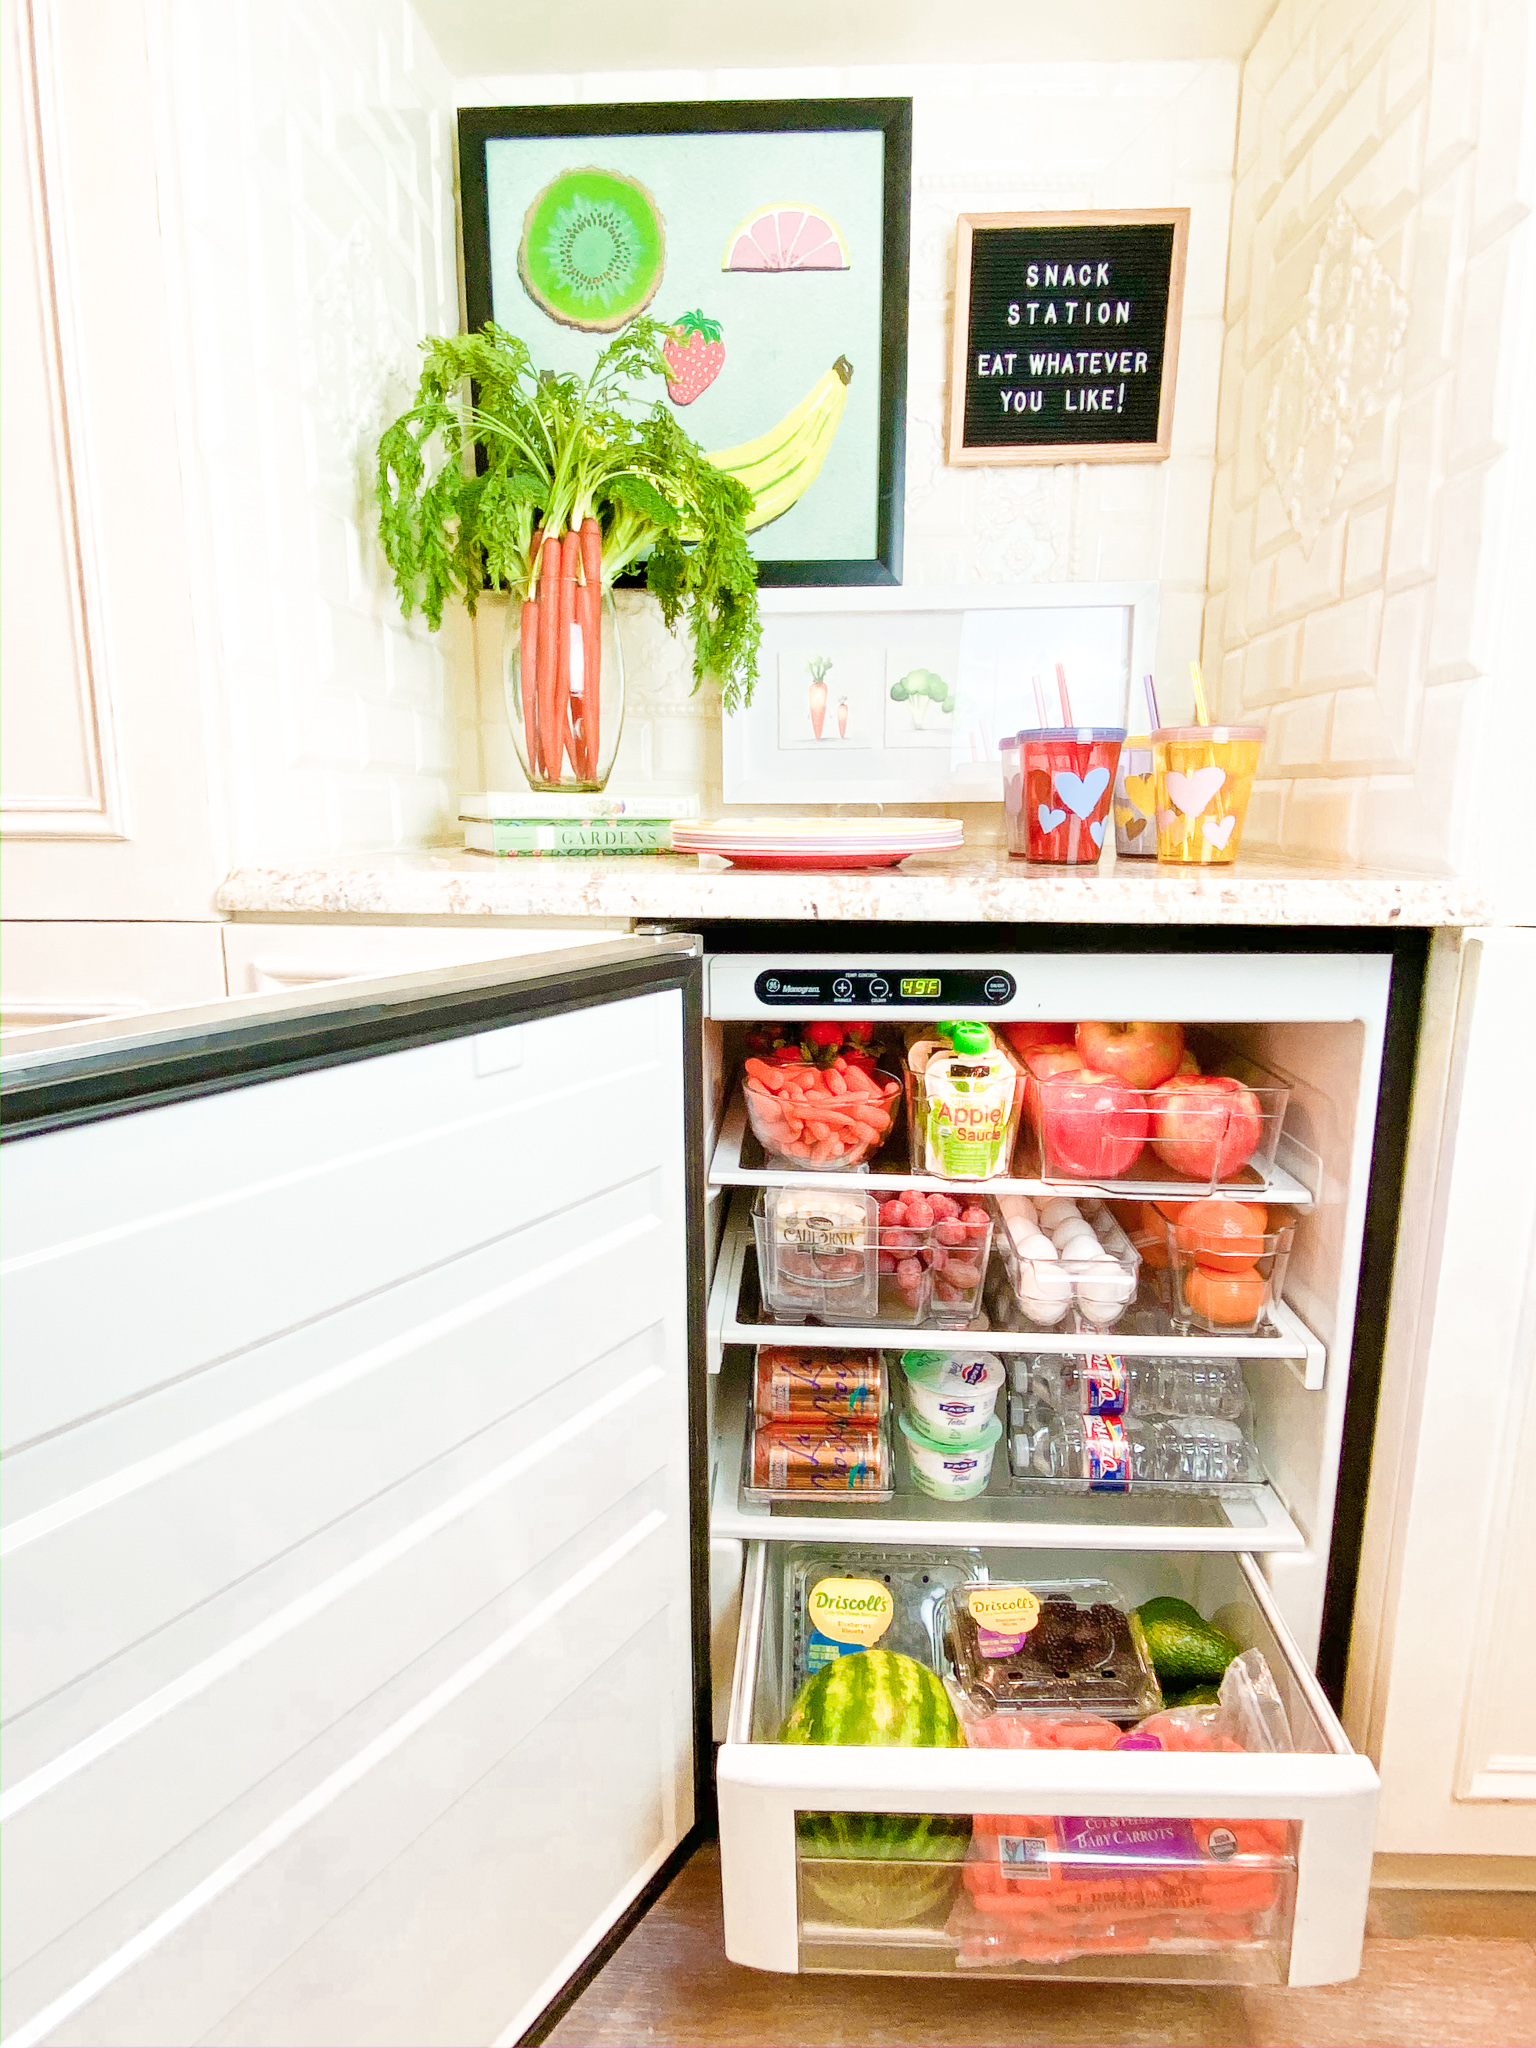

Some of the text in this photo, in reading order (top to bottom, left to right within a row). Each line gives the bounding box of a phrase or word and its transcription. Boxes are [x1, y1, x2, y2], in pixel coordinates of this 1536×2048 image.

[1026, 263, 1109, 287] SNACK
[1007, 302, 1130, 325] STATION
[977, 352, 1148, 376] EAT WHATEVER
[1000, 382, 1125, 413] YOU LIKE!
[561, 830, 658, 847] GARDENS
[903, 980, 938, 995] 49F
[938, 1102, 1001, 1126] Apple
[957, 1127, 1002, 1142] Sauce
[815, 1592, 889, 1612] Driscoll's
[973, 1598, 1034, 1612] Driscoll's
[1072, 1828, 1175, 1848] BABY CARROTS
